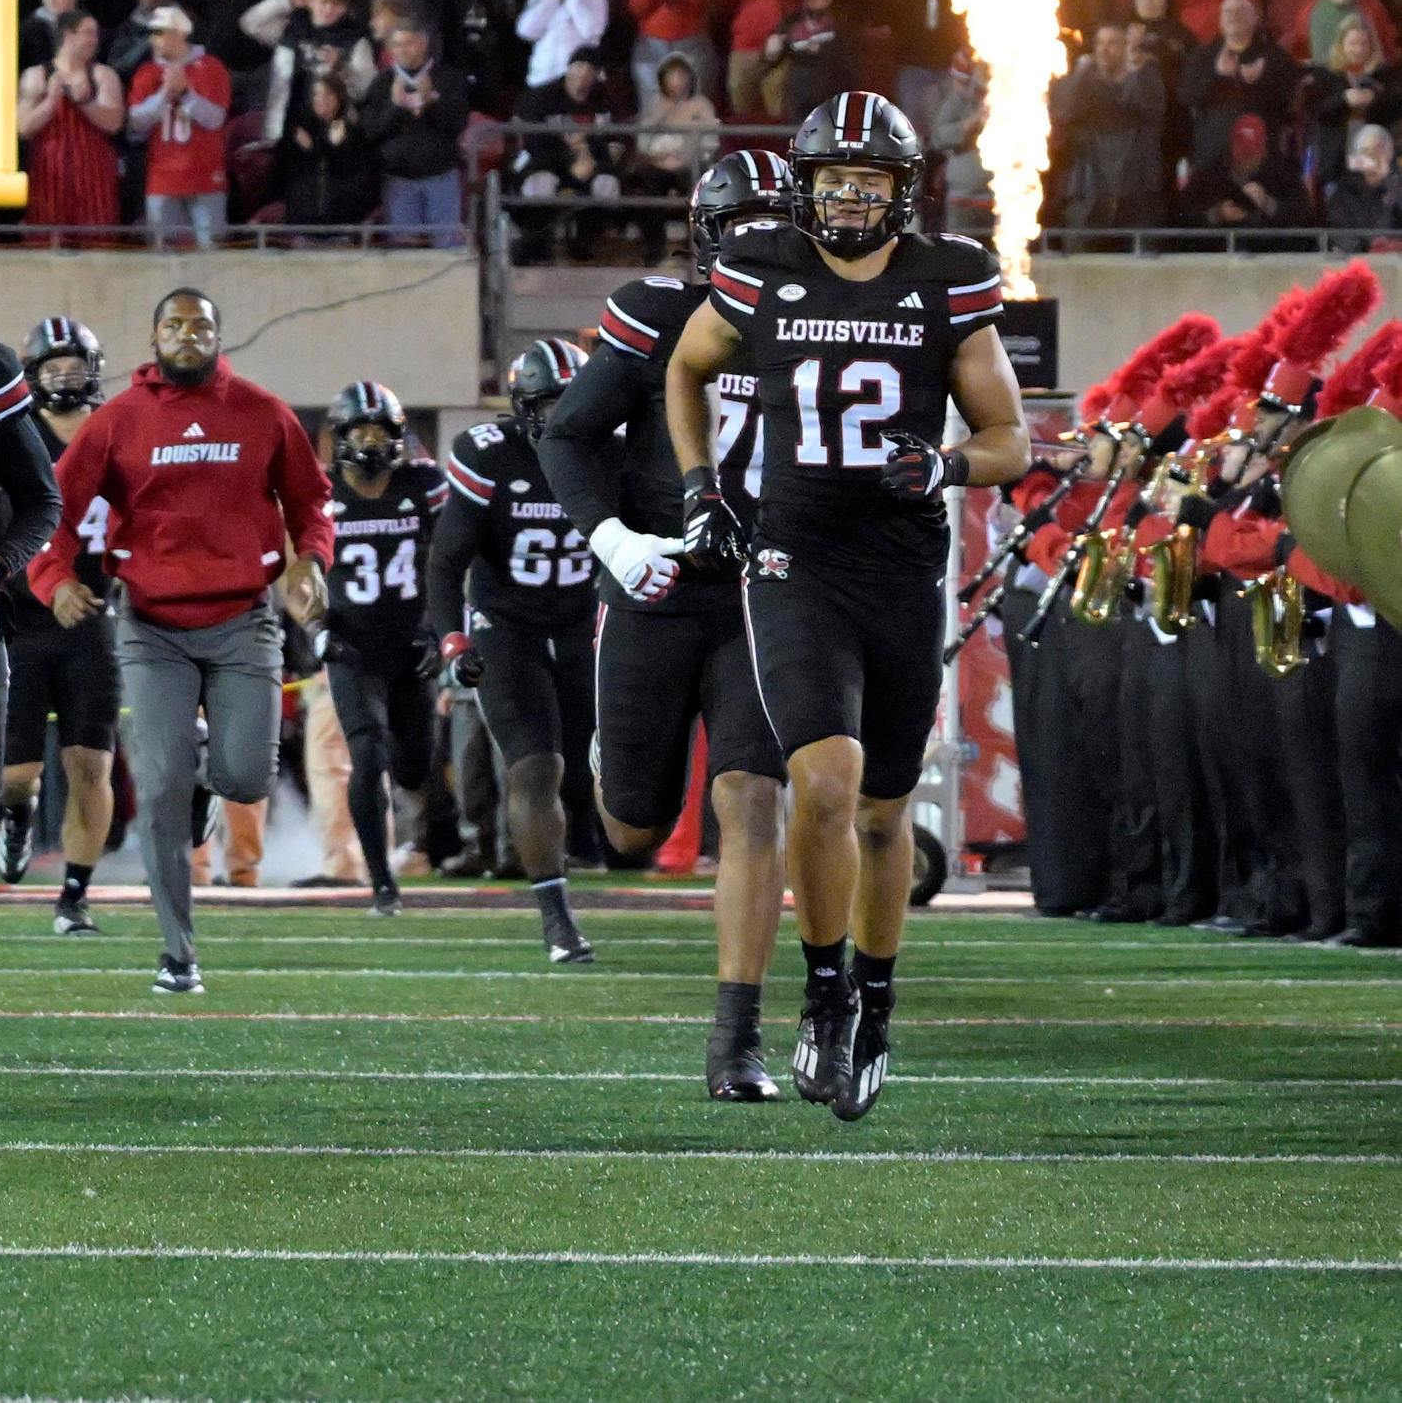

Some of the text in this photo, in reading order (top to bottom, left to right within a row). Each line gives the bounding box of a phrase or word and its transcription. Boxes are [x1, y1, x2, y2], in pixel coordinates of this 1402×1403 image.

[776, 318, 925, 346] LOUISVILLE
[792, 358, 903, 469] 12
[151, 443, 240, 466] LOUISVILLE
[717, 398, 764, 498] 7
[333, 516, 420, 536] LOUISVILLE
[341, 539, 418, 605] 34
[509, 528, 593, 586] 62
